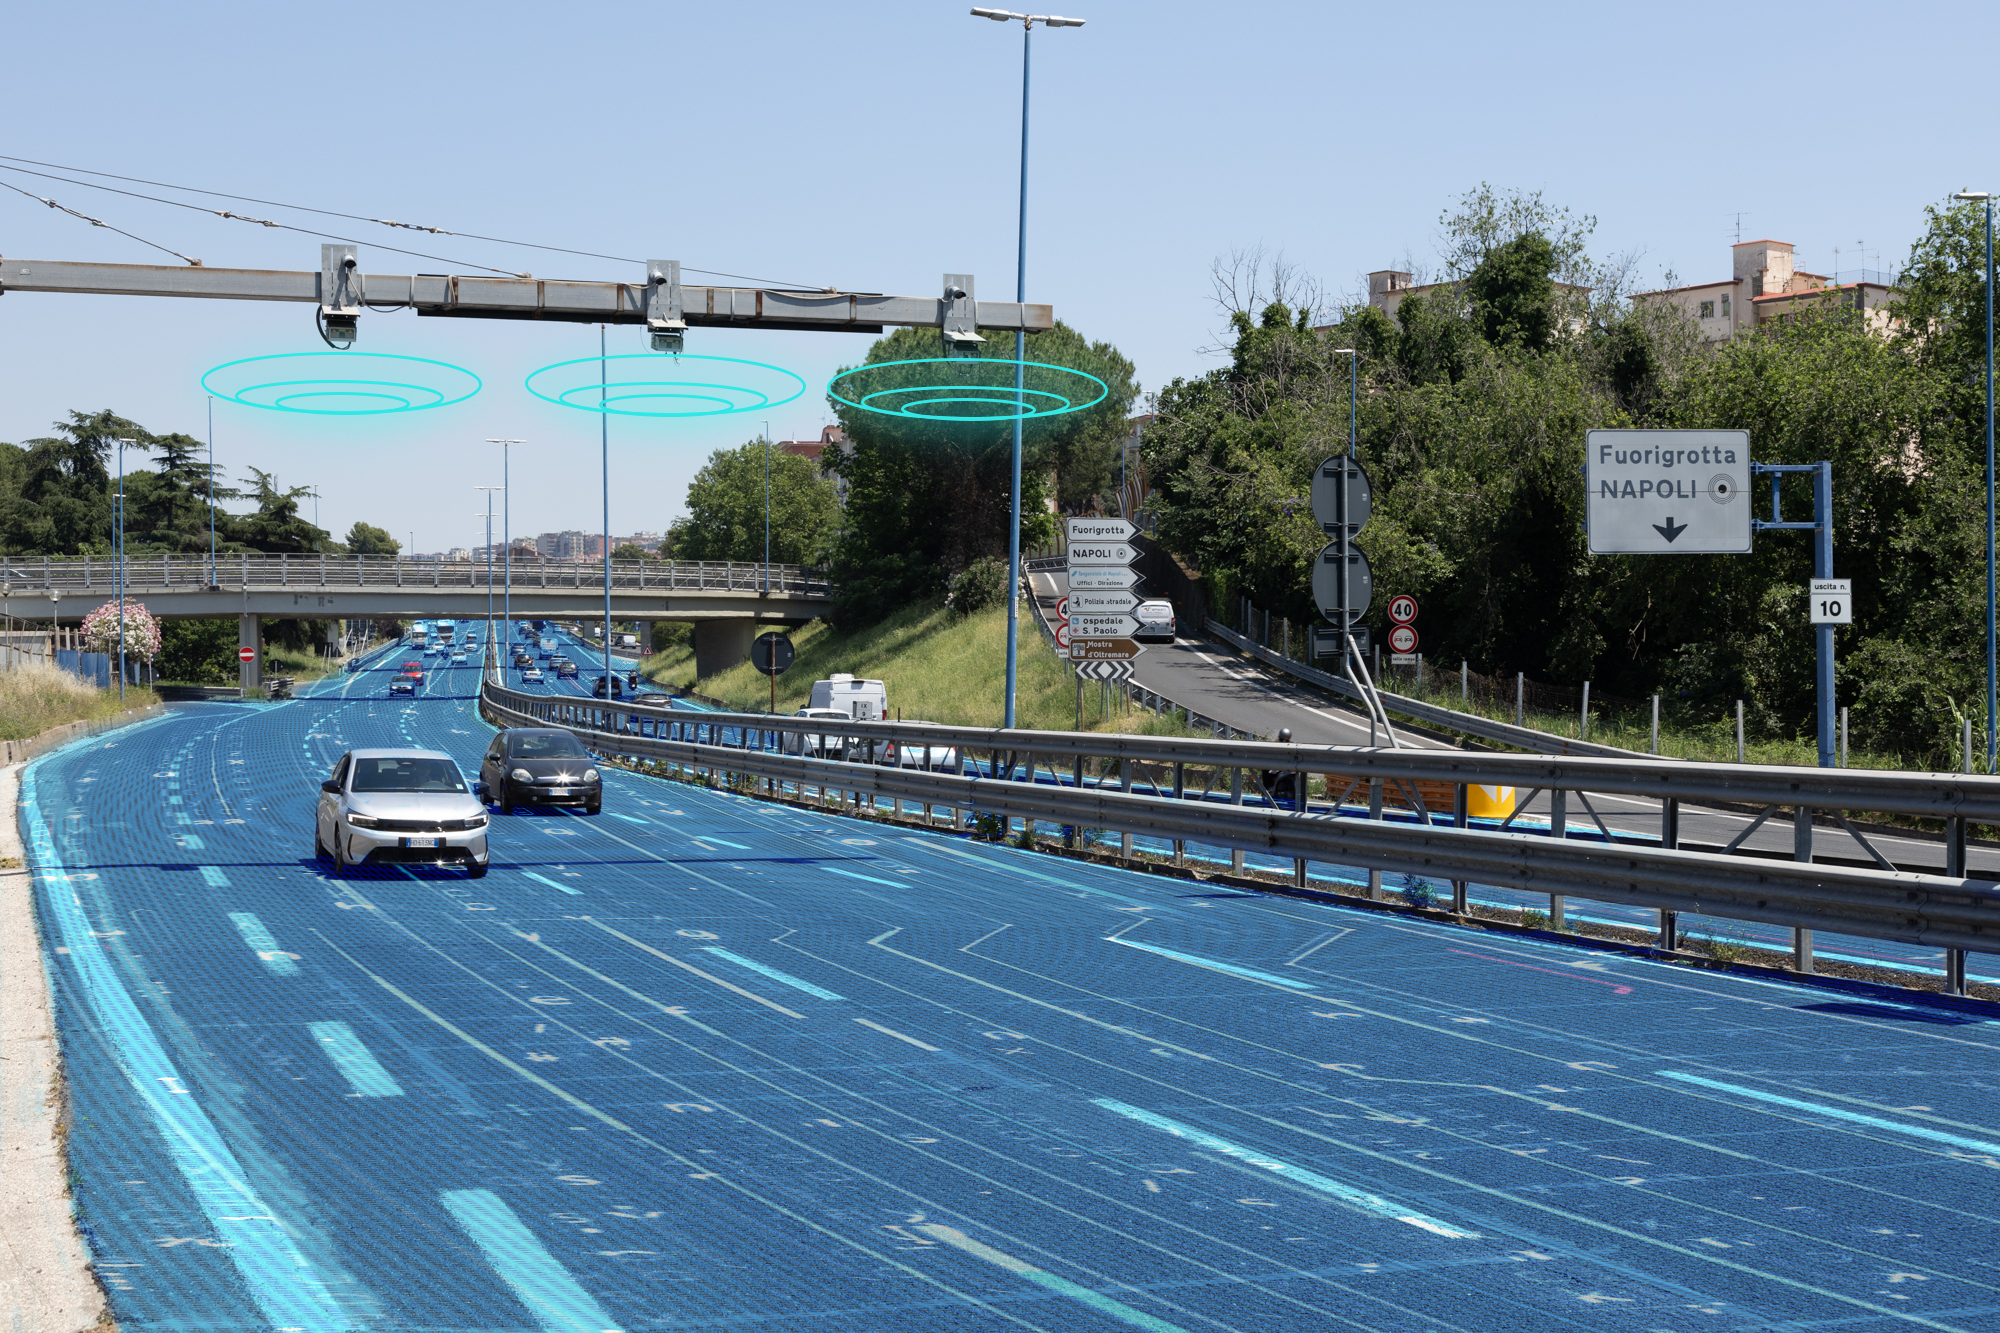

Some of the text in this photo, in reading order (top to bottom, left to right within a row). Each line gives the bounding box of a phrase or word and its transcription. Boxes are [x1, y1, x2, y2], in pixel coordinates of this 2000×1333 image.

[1600, 445, 1736, 468] Fuorigrotta
[1601, 479, 1696, 499] NAPOLI
[1072, 526, 1125, 536] Fuorigrotta
[1073, 550, 1110, 558] NAPOLI
[1814, 582, 1836, 590] uscita
[1061, 604, 1068, 615] 4
[1394, 603, 1412, 616] 40
[1820, 600, 1841, 617] 10
